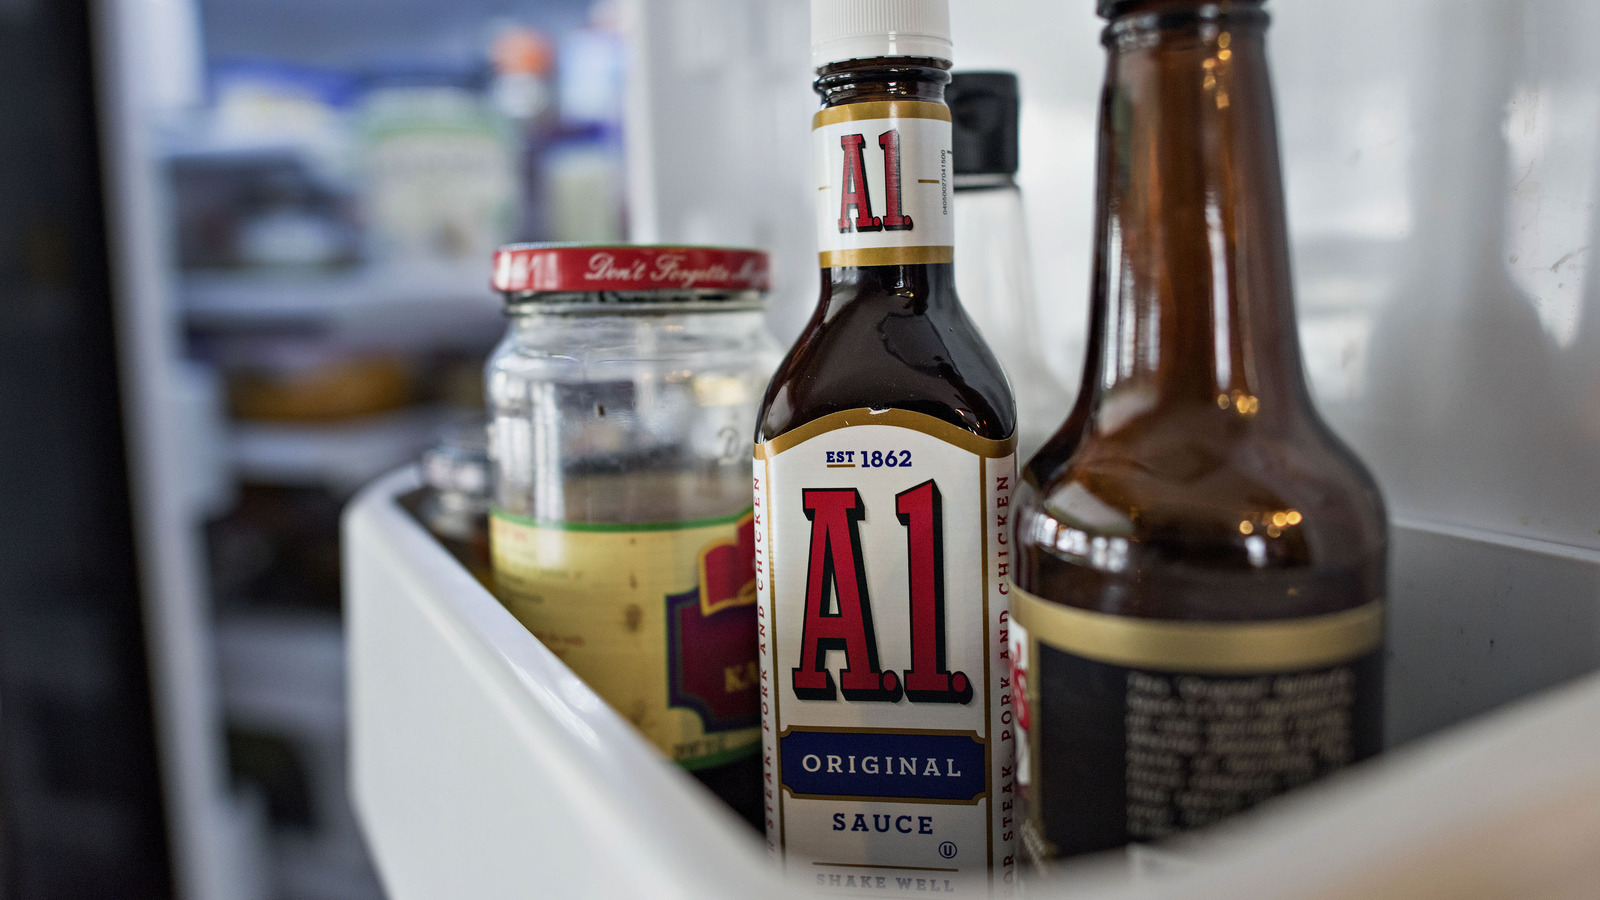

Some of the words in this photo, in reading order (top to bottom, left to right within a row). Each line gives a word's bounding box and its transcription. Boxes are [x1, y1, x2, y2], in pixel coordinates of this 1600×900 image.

[838, 129, 914, 234] A.1.
[584, 252, 647, 282] Don't
[826, 451, 855, 463] EST
[861, 450, 912, 468] 1862
[753, 477, 764, 591] CHICKEN
[997, 477, 1009, 596] CHICKEN
[792, 478, 973, 705] A.1.
[758, 605, 767, 656] AND
[999, 610, 1009, 660] AND
[760, 668, 770, 732] PORK
[1001, 676, 1011, 742] PORK
[802, 754, 961, 777] ORIGINAL
[832, 813, 933, 834] SAUCE
[816, 873, 886, 889] SHAKE
[895, 877, 954, 892] WELL
